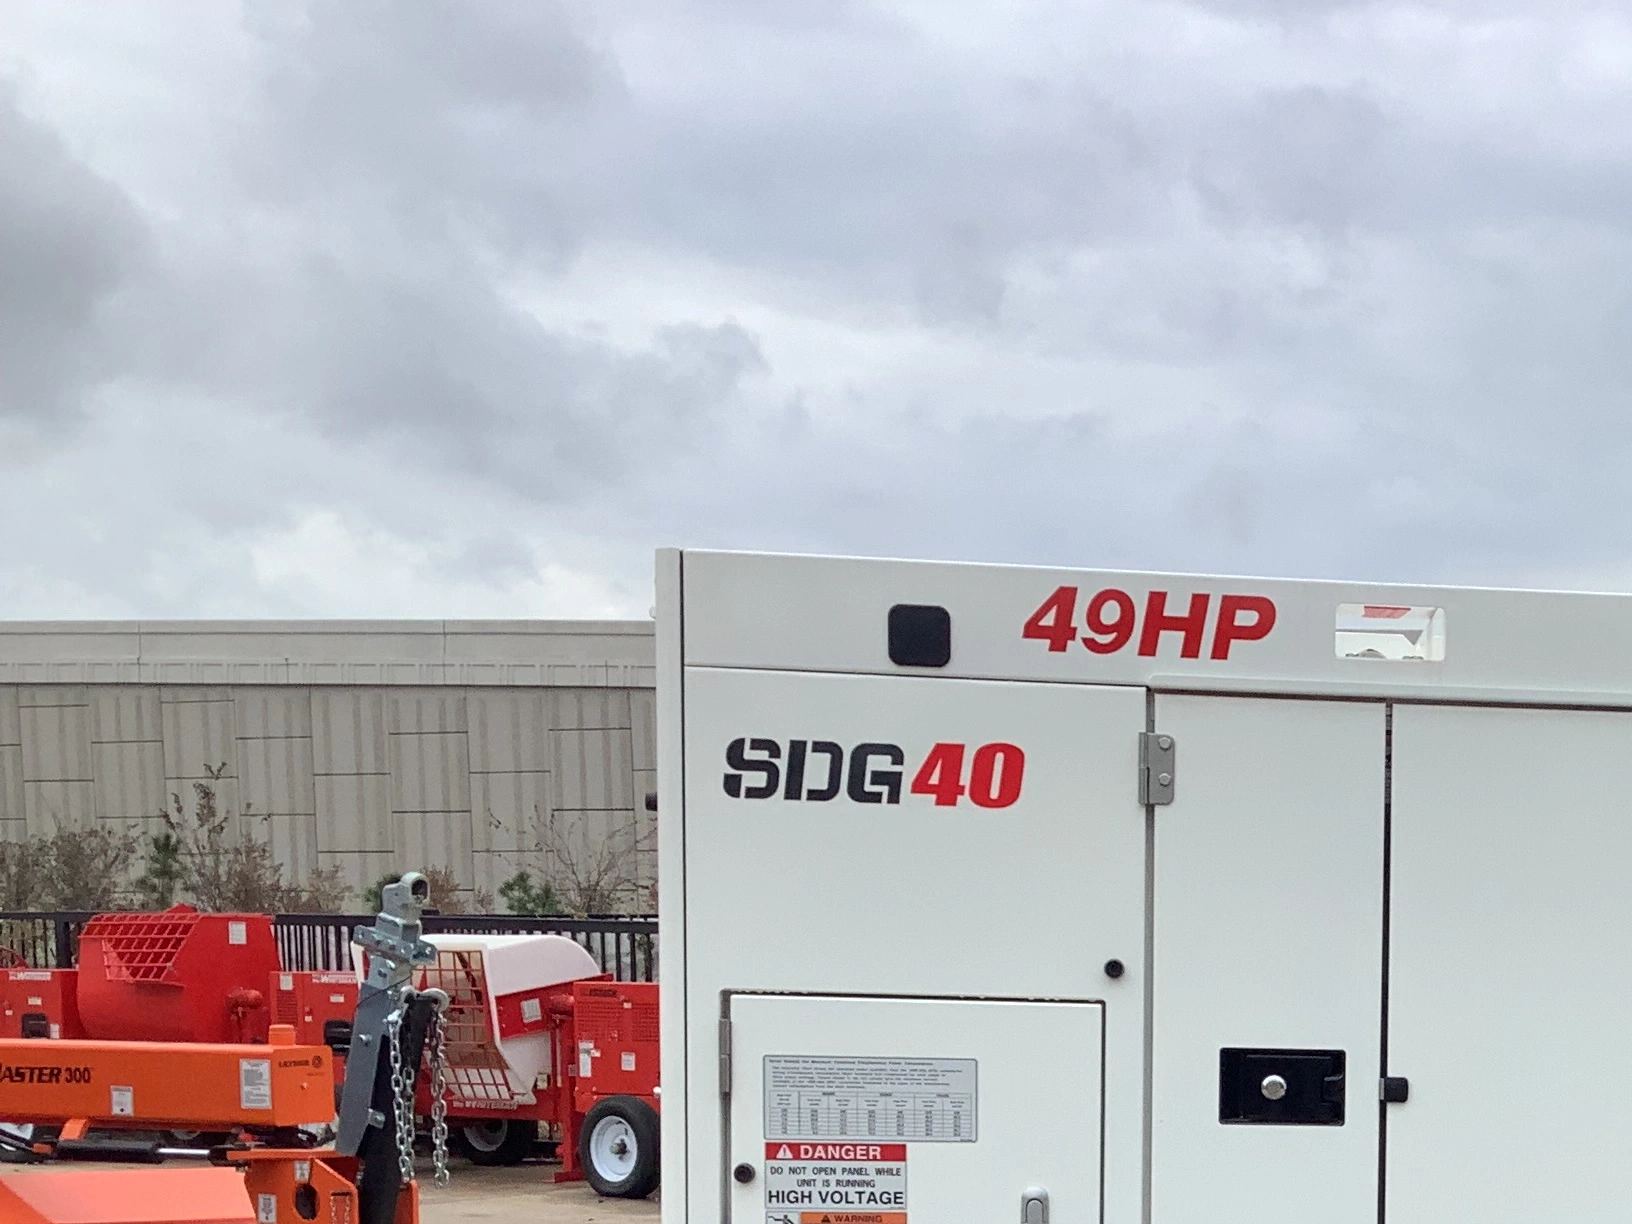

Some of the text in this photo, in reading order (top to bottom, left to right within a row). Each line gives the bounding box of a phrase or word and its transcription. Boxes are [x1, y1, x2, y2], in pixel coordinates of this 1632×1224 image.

[1022, 586, 1277, 660] 49HP
[723, 737, 1025, 809] SDG40
[0, 1063, 92, 1083] ASTER 300
[799, 1144, 882, 1160] DANGER
[770, 1166, 902, 1177] DO NOT OPEN PANEL WHILE
[796, 1179, 876, 1188] UNIT IS RUNNING
[768, 1190, 904, 1205] HIGH VOLTAGE
[833, 1214, 883, 1224] WARNING
